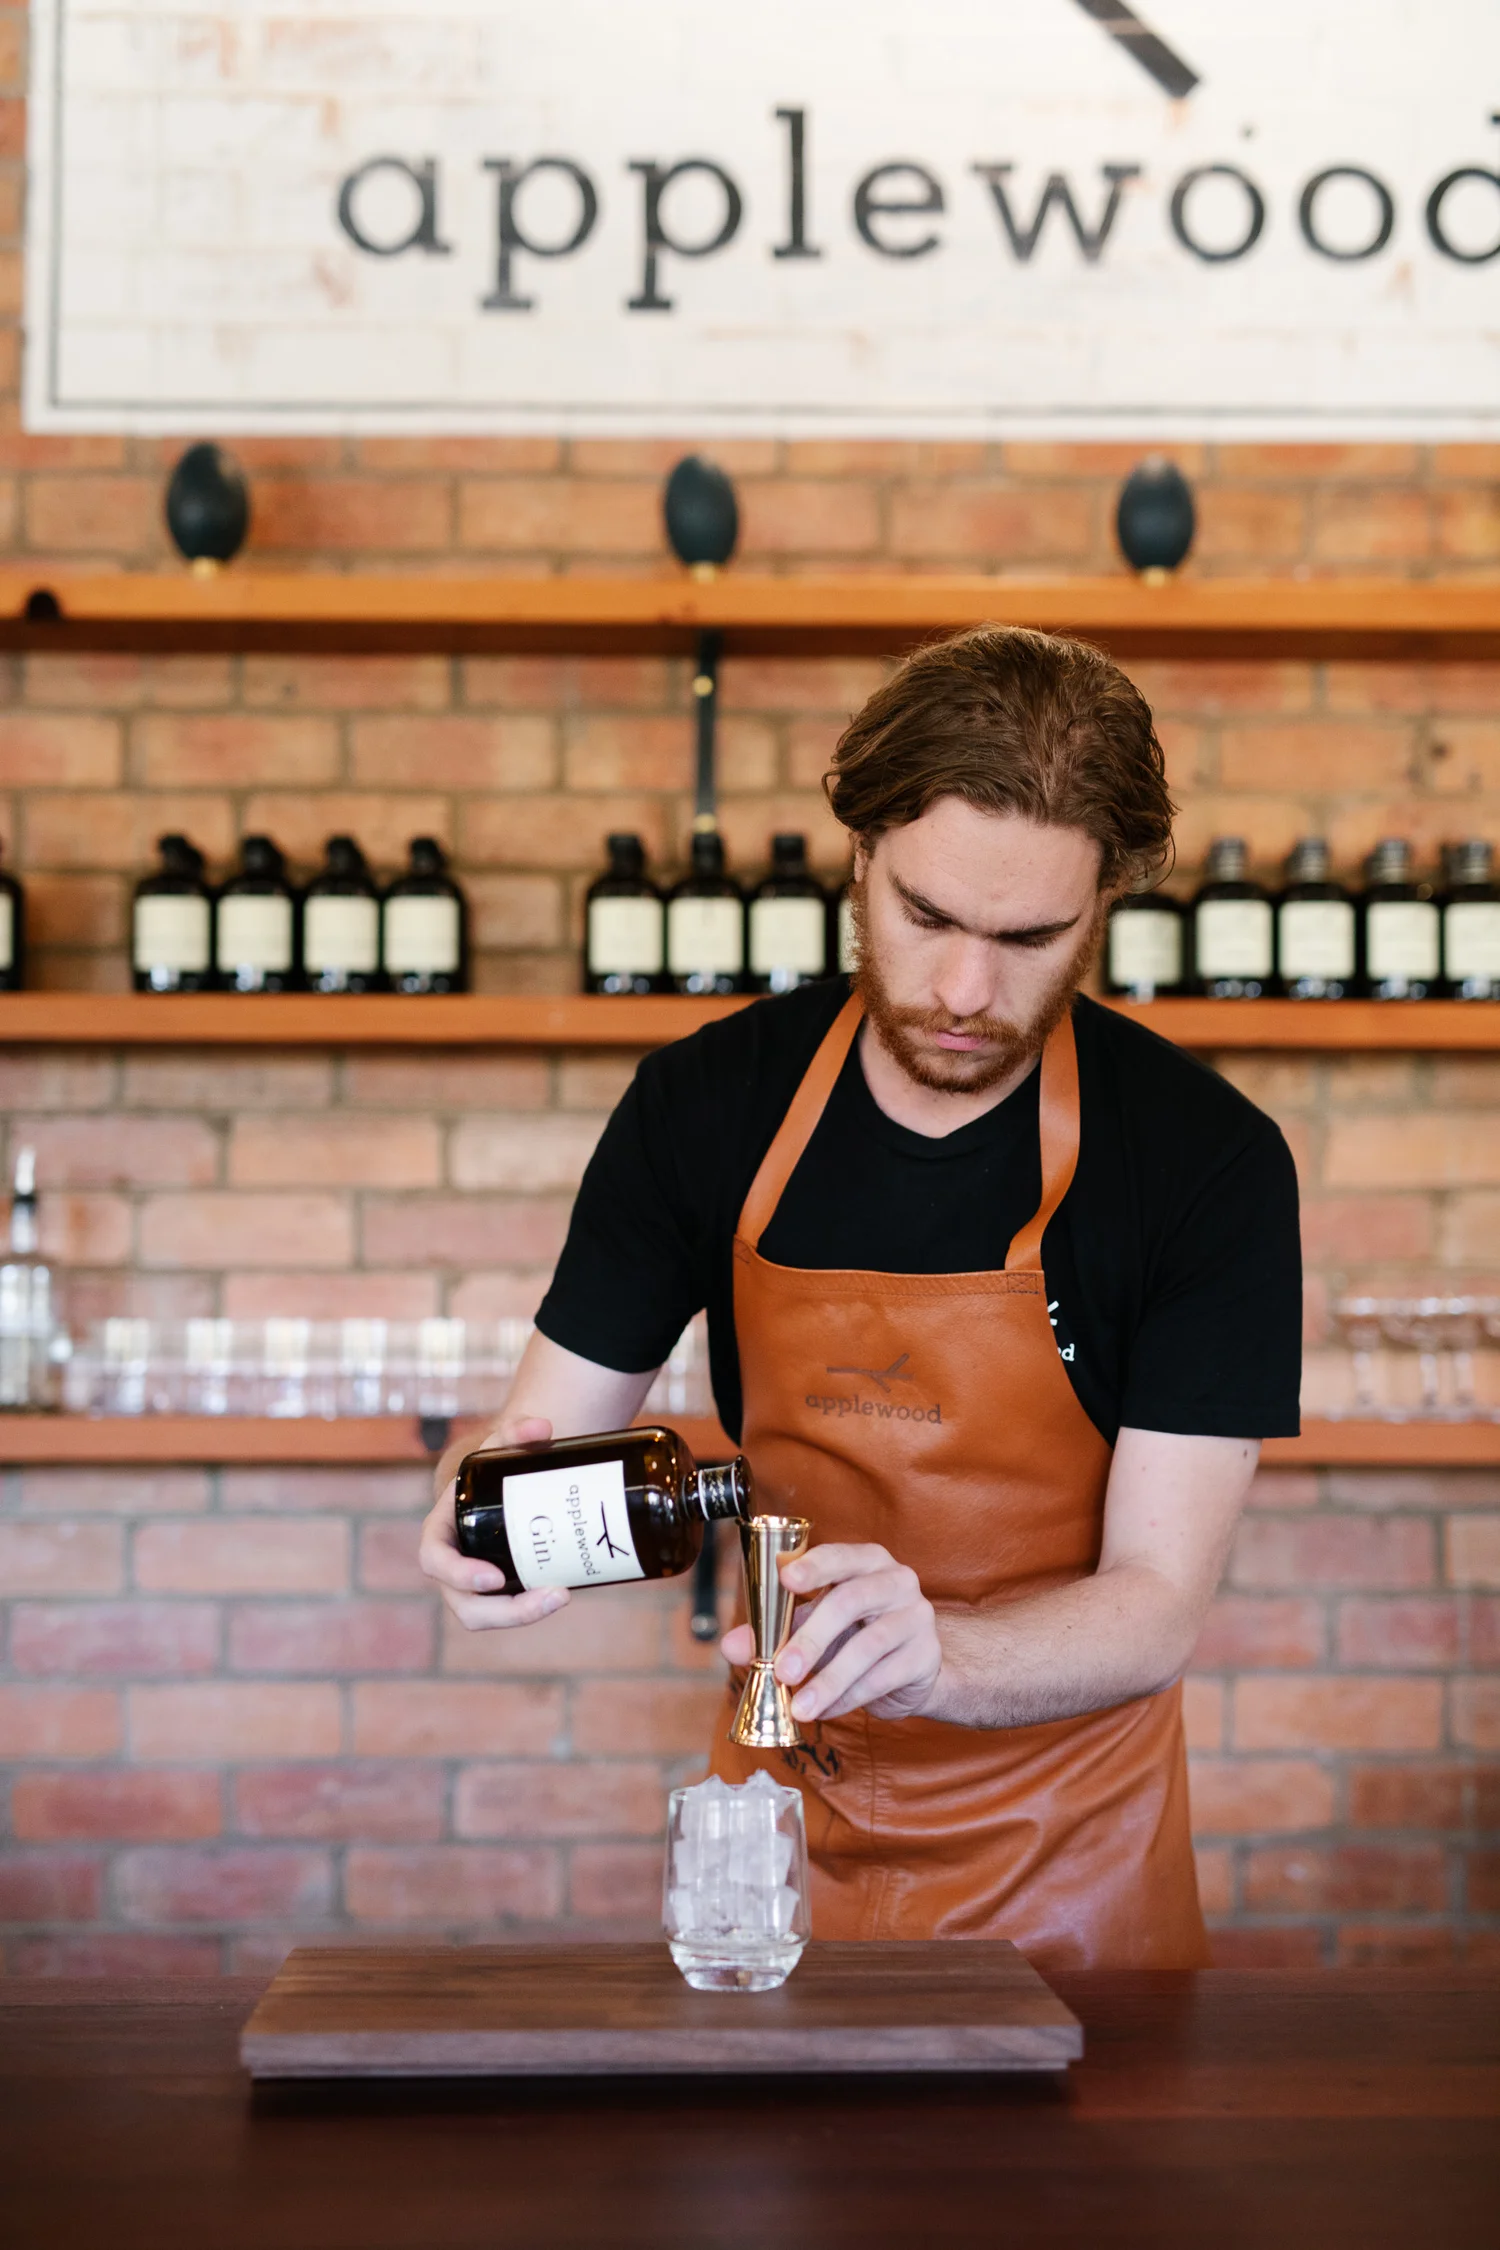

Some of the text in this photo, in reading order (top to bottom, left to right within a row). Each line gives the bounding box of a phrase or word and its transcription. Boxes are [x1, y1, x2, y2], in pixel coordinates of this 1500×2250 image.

[805, 1394, 942, 1425] applewood
[529, 1514, 555, 1571] Gin.
[565, 1484, 601, 1577] applewood
